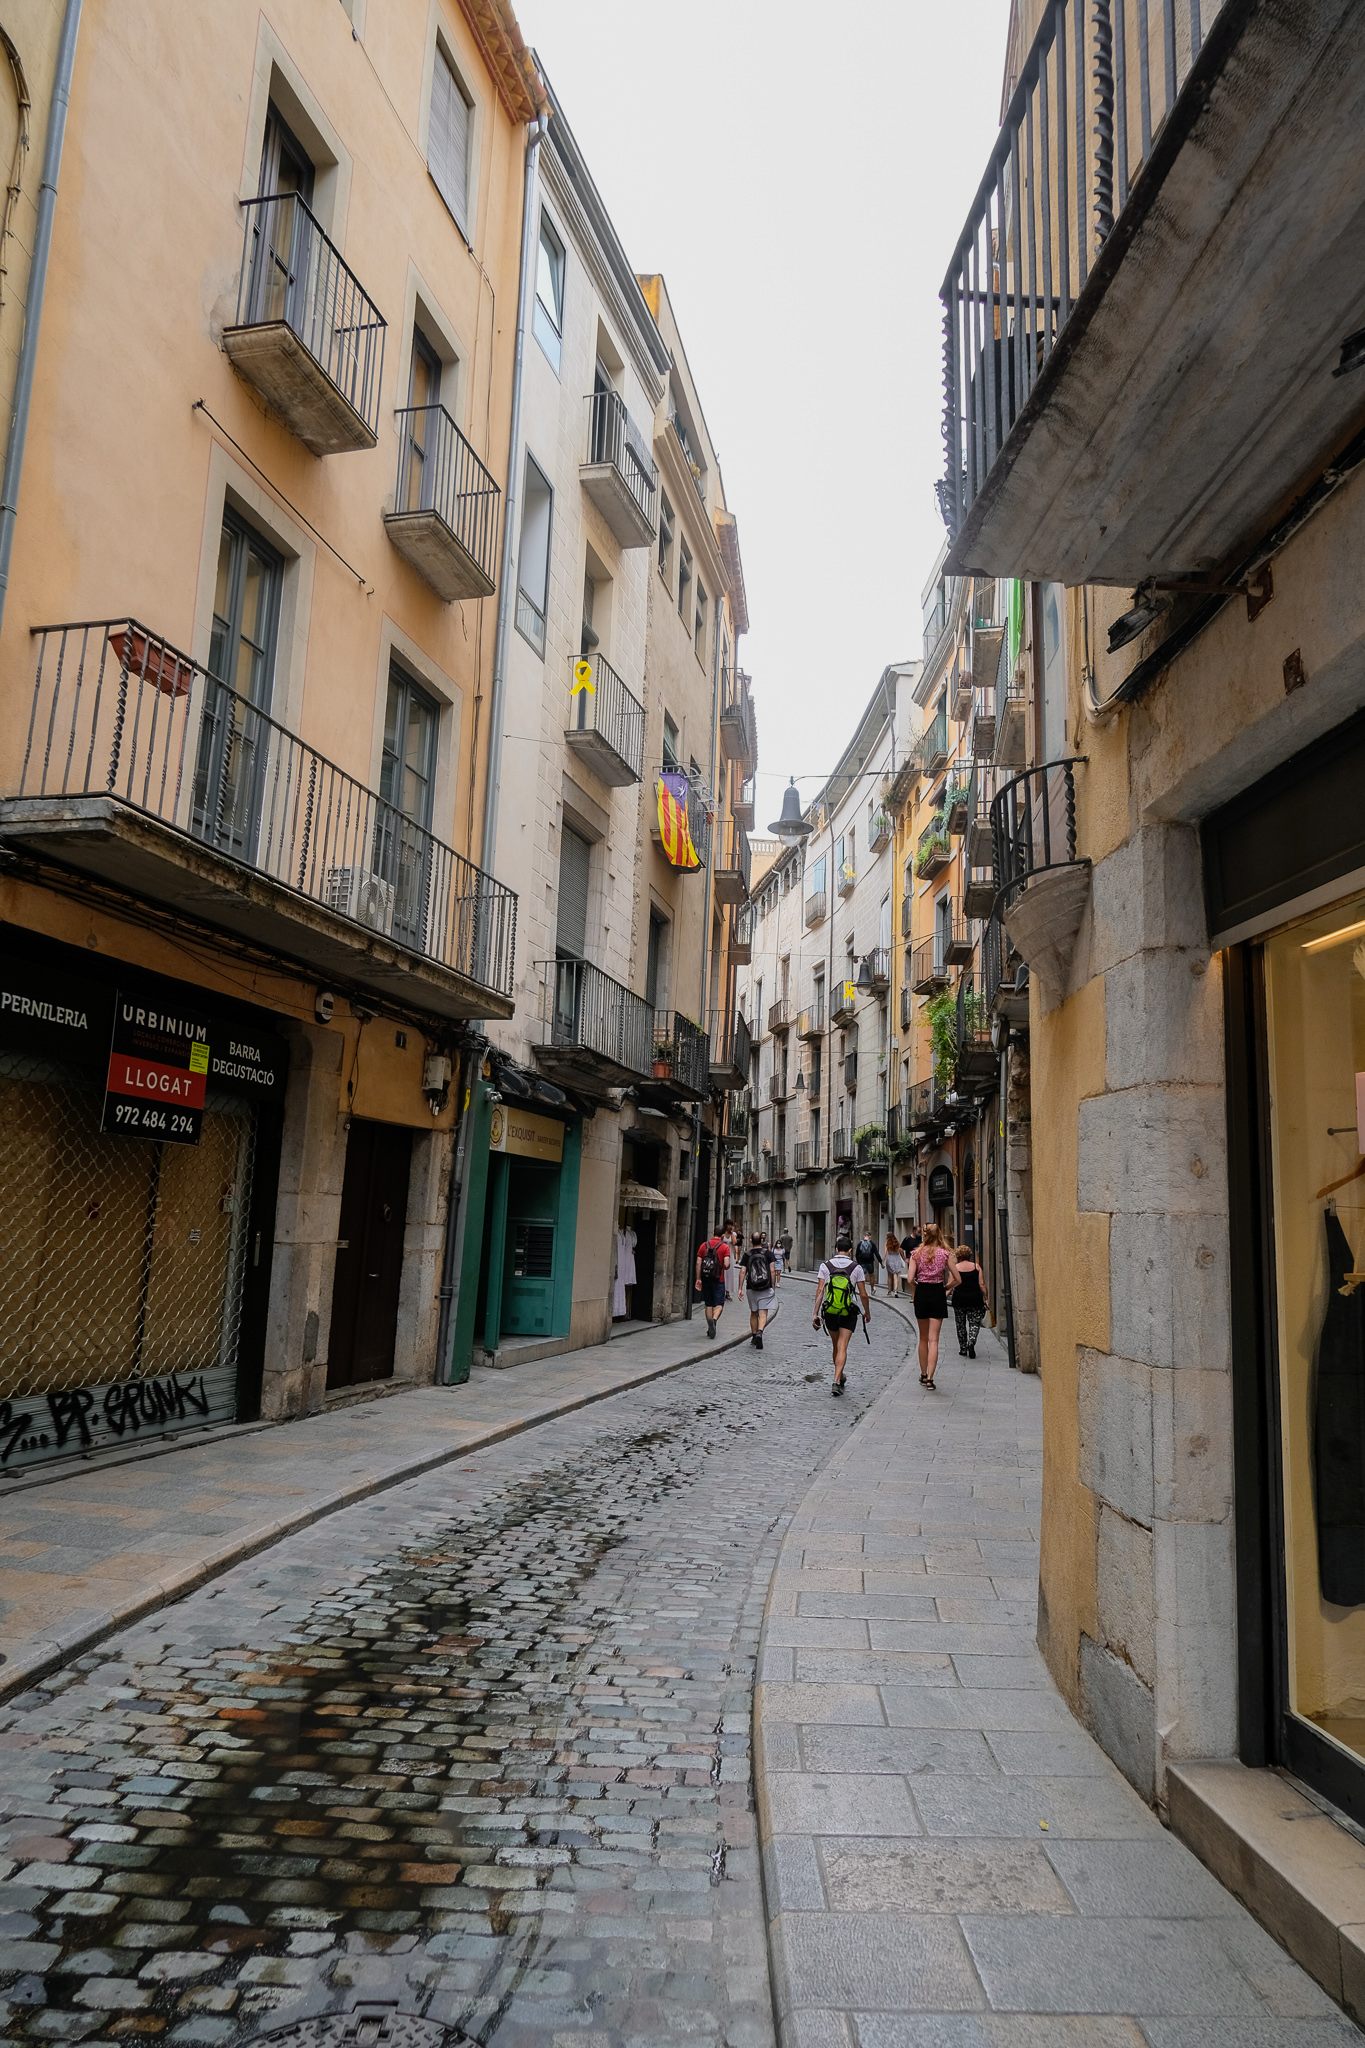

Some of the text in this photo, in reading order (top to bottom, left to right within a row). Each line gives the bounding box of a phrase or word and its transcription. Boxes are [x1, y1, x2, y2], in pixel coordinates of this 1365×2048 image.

[1, 992, 88, 1030] PERNILERIA
[122, 1004, 207, 1042] URBINIUM
[133, 1029, 156, 1041] LOCALS
[229, 1041, 261, 1062] BARRA
[125, 1066, 192, 1097] LLOGAT
[212, 1058, 275, 1086] DEGUSTACIÓ
[115, 1104, 193, 1134] 972 484 294
[507, 1125, 536, 1142] L'EXQUISIT
